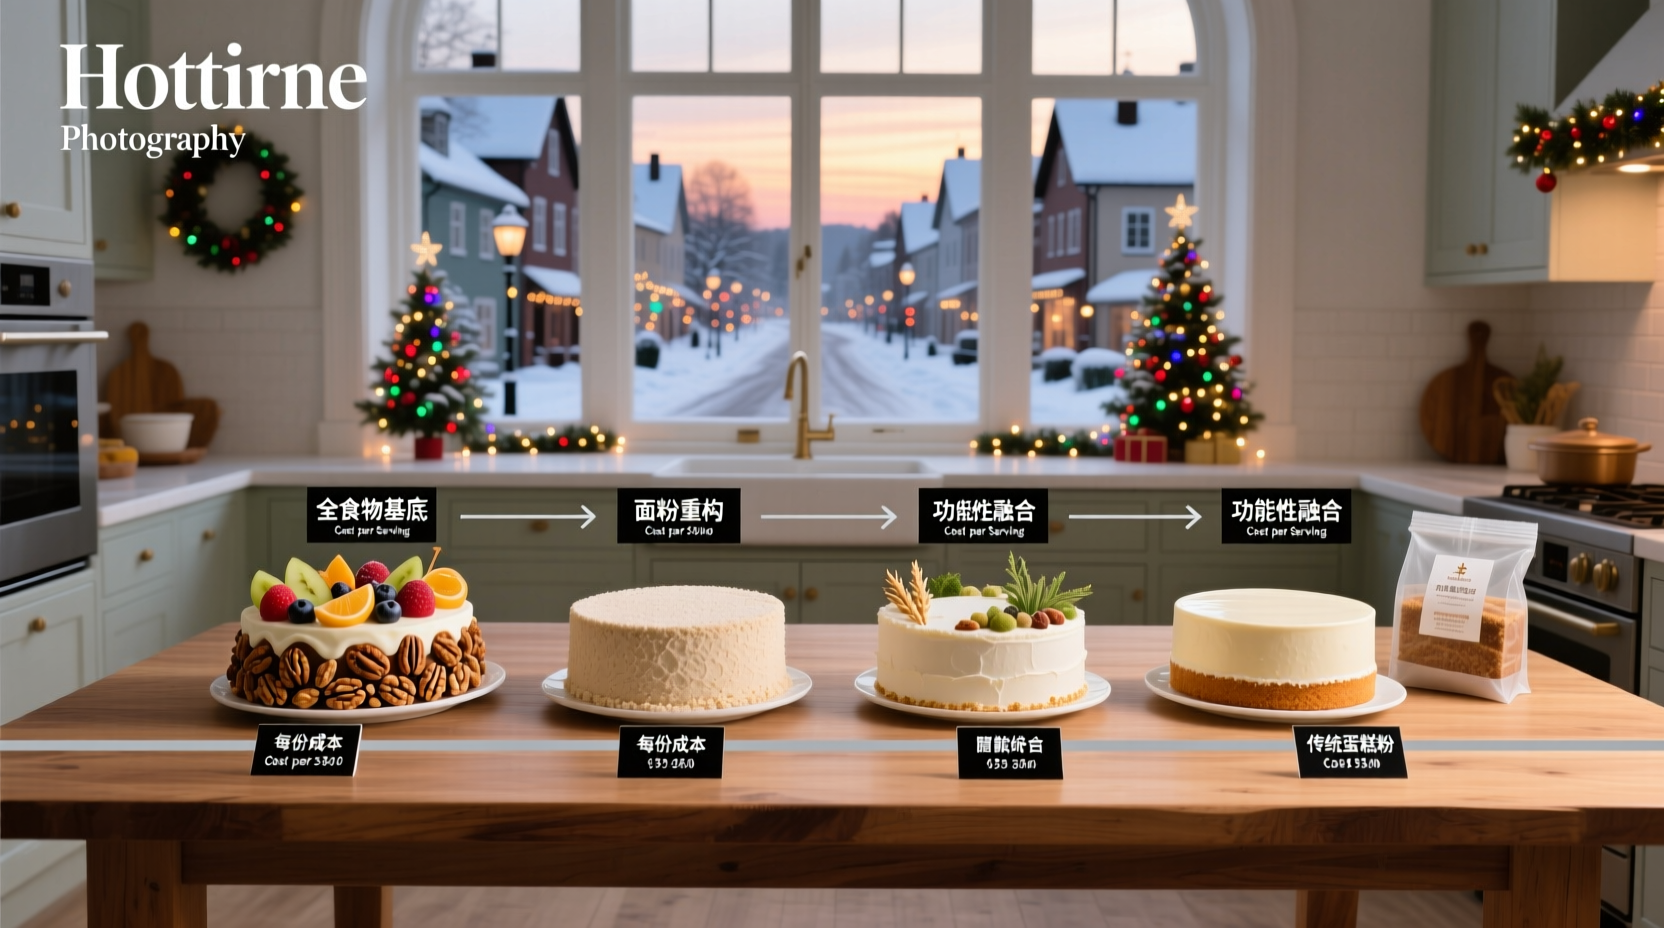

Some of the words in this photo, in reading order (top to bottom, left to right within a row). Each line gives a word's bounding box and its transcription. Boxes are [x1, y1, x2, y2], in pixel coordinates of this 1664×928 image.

[274, 732, 343, 752] 每份成本
[636, 734, 706, 754] 每份成本
[1306, 733, 1395, 754] 传统蛋糕粉
[264, 755, 289, 767] Cost
[291, 756, 313, 770] per
